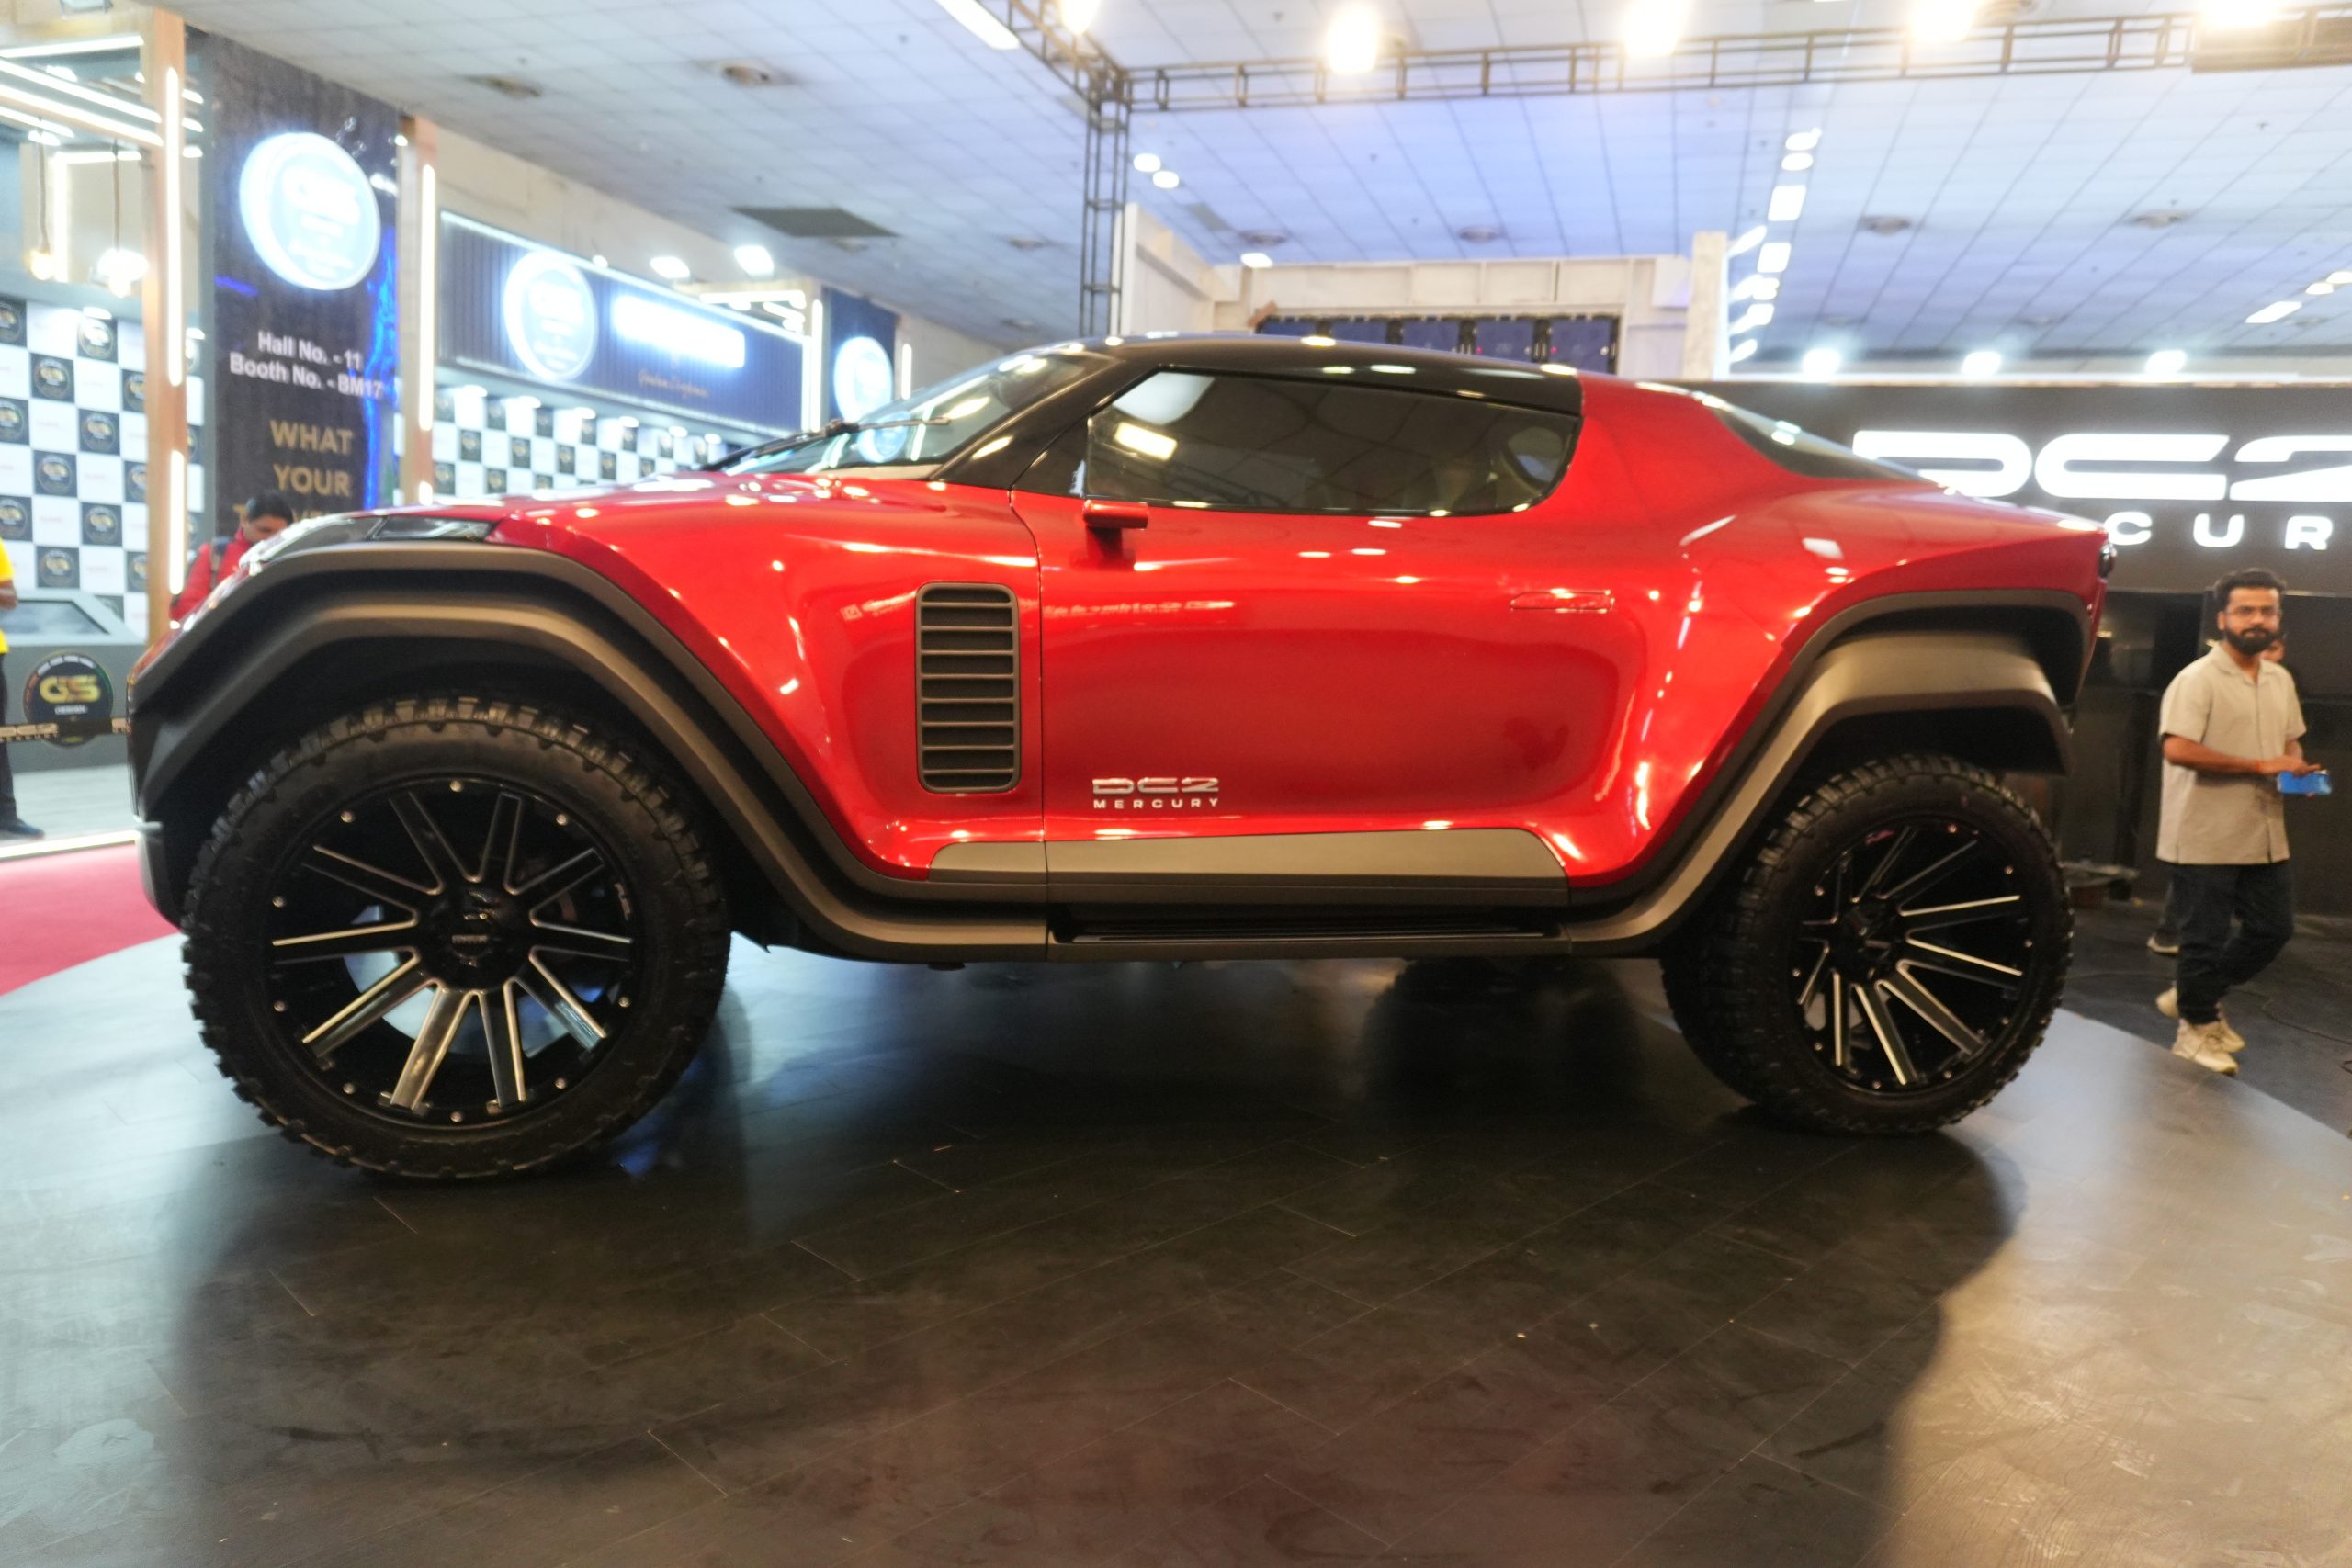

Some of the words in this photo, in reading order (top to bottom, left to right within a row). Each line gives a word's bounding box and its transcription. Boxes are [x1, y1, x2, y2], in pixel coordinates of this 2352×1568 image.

[257, 330, 293, 356] Hall
[298, 340, 329, 364] No.
[344, 349, 362, 368] 11
[230, 352, 288, 383] Booth
[292, 364, 322, 389] No.
[337, 373, 384, 399] BM17
[269, 419, 355, 455] WHAT
[272, 463, 352, 497] YOUR
[1092, 777, 1219, 795] DC2
[1092, 798, 1219, 809] MERCURY
